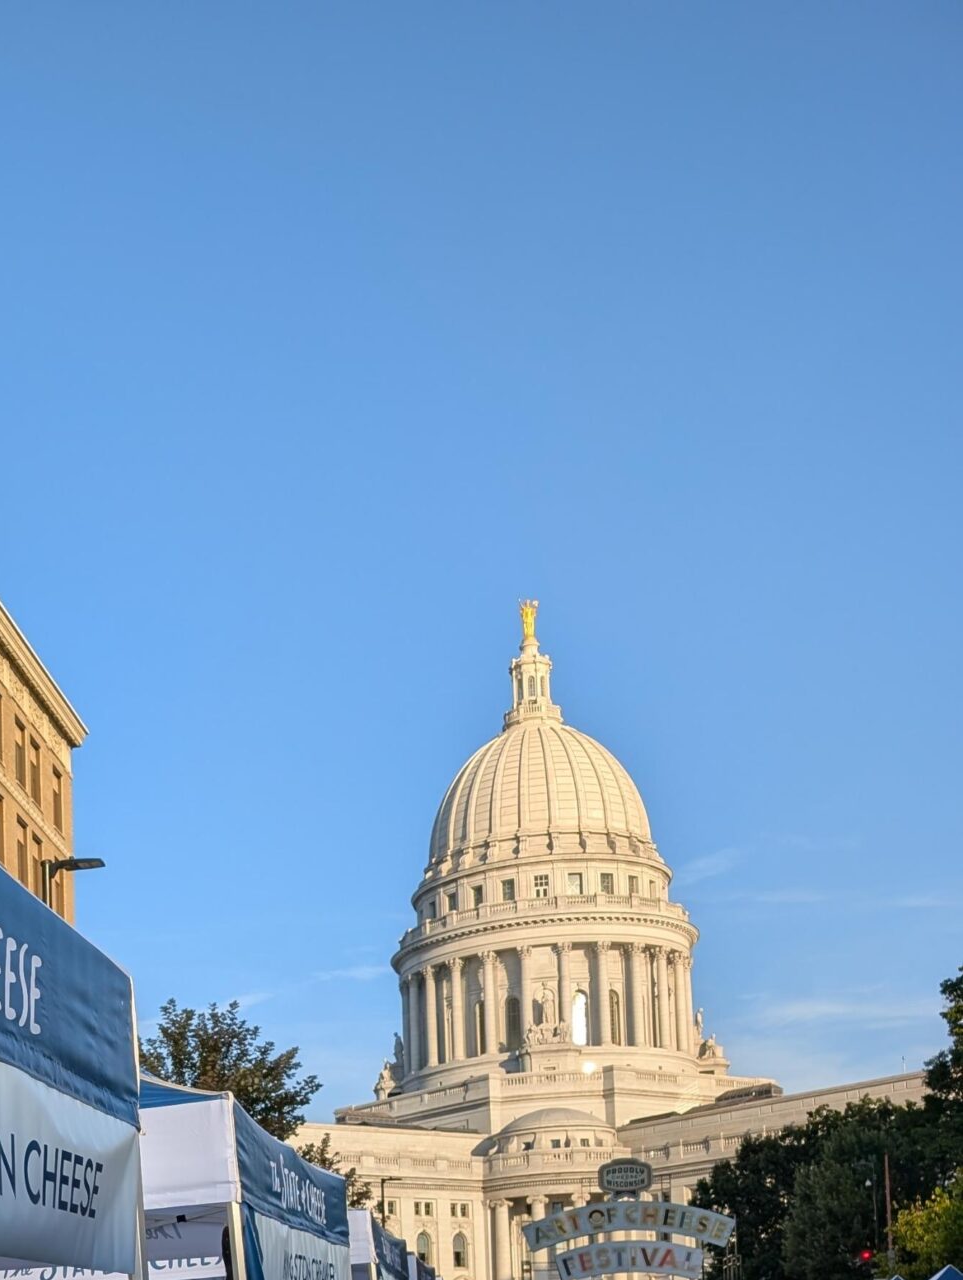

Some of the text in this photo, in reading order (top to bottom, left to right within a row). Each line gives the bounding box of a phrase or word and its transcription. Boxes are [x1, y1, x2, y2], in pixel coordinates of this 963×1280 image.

[24, 1138, 103, 1219] CHEESE
[606, 1167, 645, 1177] PROUDLY
[607, 1179, 645, 1188] WISCONSIN
[535, 1206, 728, 1244] ART OF CHEESE
[561, 1247, 696, 1277] FESTIVAL
